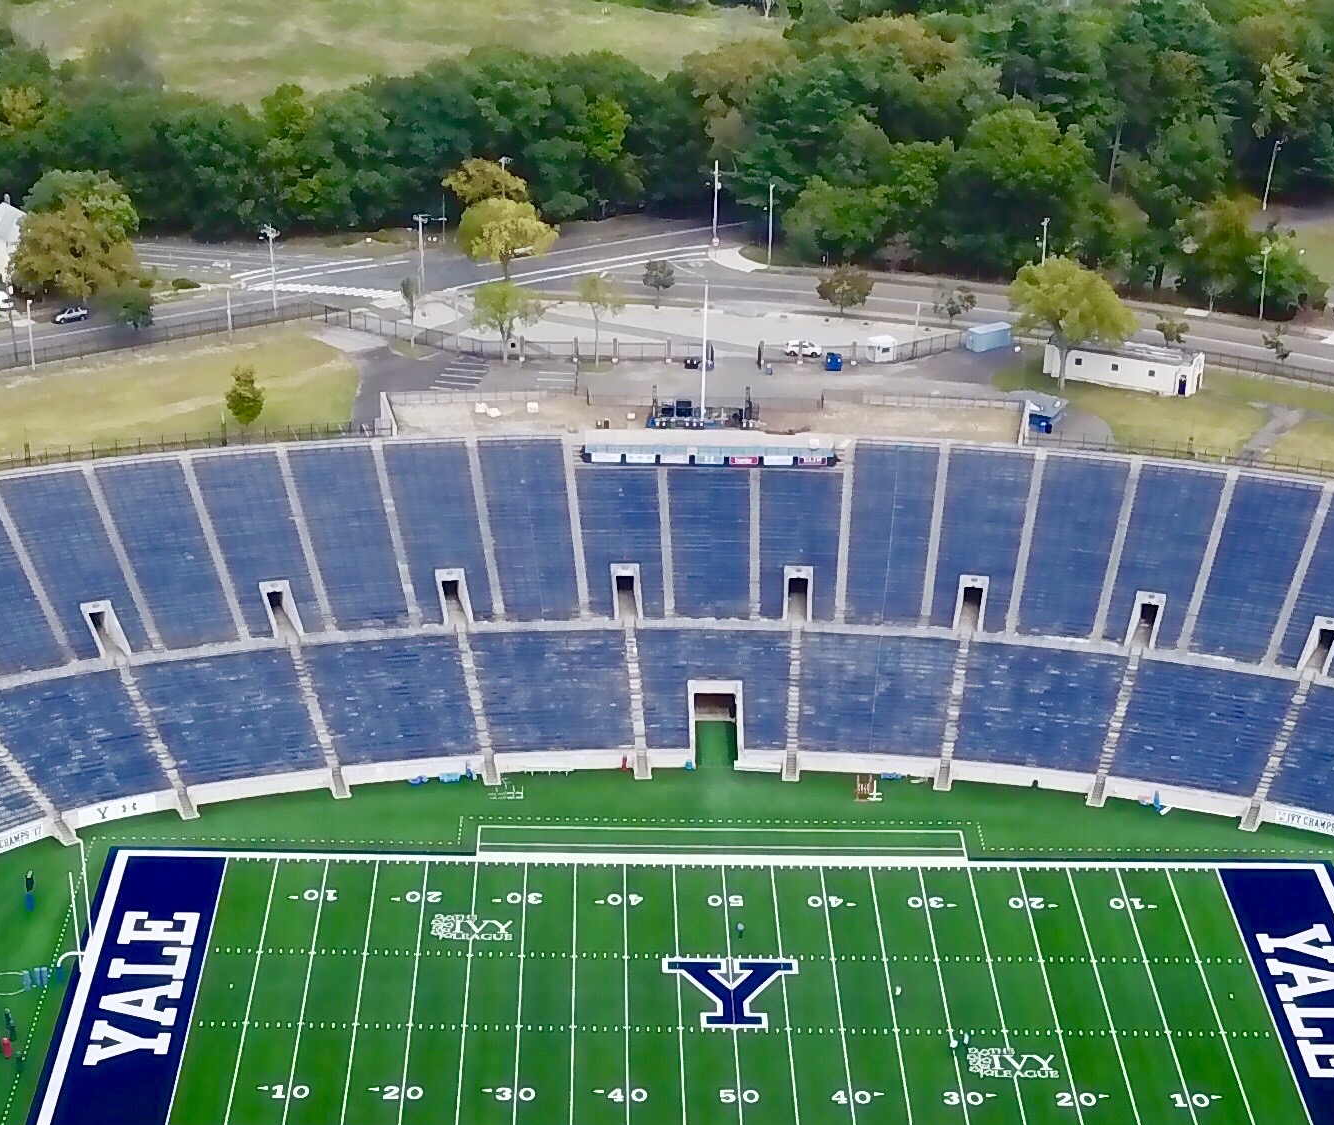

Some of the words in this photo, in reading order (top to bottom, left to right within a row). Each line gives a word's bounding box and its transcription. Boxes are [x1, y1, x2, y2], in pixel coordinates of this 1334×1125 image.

[97, 806, 108, 819] Y
[304, 890, 337, 901] 10
[405, 891, 442, 902] 20
[506, 892, 543, 904] 30
[607, 893, 643, 905] 40
[707, 895, 744, 907] 50
[807, 895, 843, 908] 40
[907, 896, 944, 909] 30
[1008, 897, 1044, 909] 20
[1109, 897, 1145, 910] 10
[452, 920, 512, 933] IVY
[83, 911, 200, 1066] YALE
[662, 958, 799, 1028] Y
[990, 1055, 1054, 1070] IVY
[271, 1084, 310, 1099] 10
[383, 1085, 423, 1100] 20
[495, 1087, 535, 1101] 30
[608, 1088, 648, 1102] 40
[719, 1089, 759, 1103] 50
[831, 1090, 871, 1104] 40
[943, 1091, 984, 1106] 30
[1055, 1092, 1097, 1107] 20
[1170, 1093, 1210, 1107] 10
